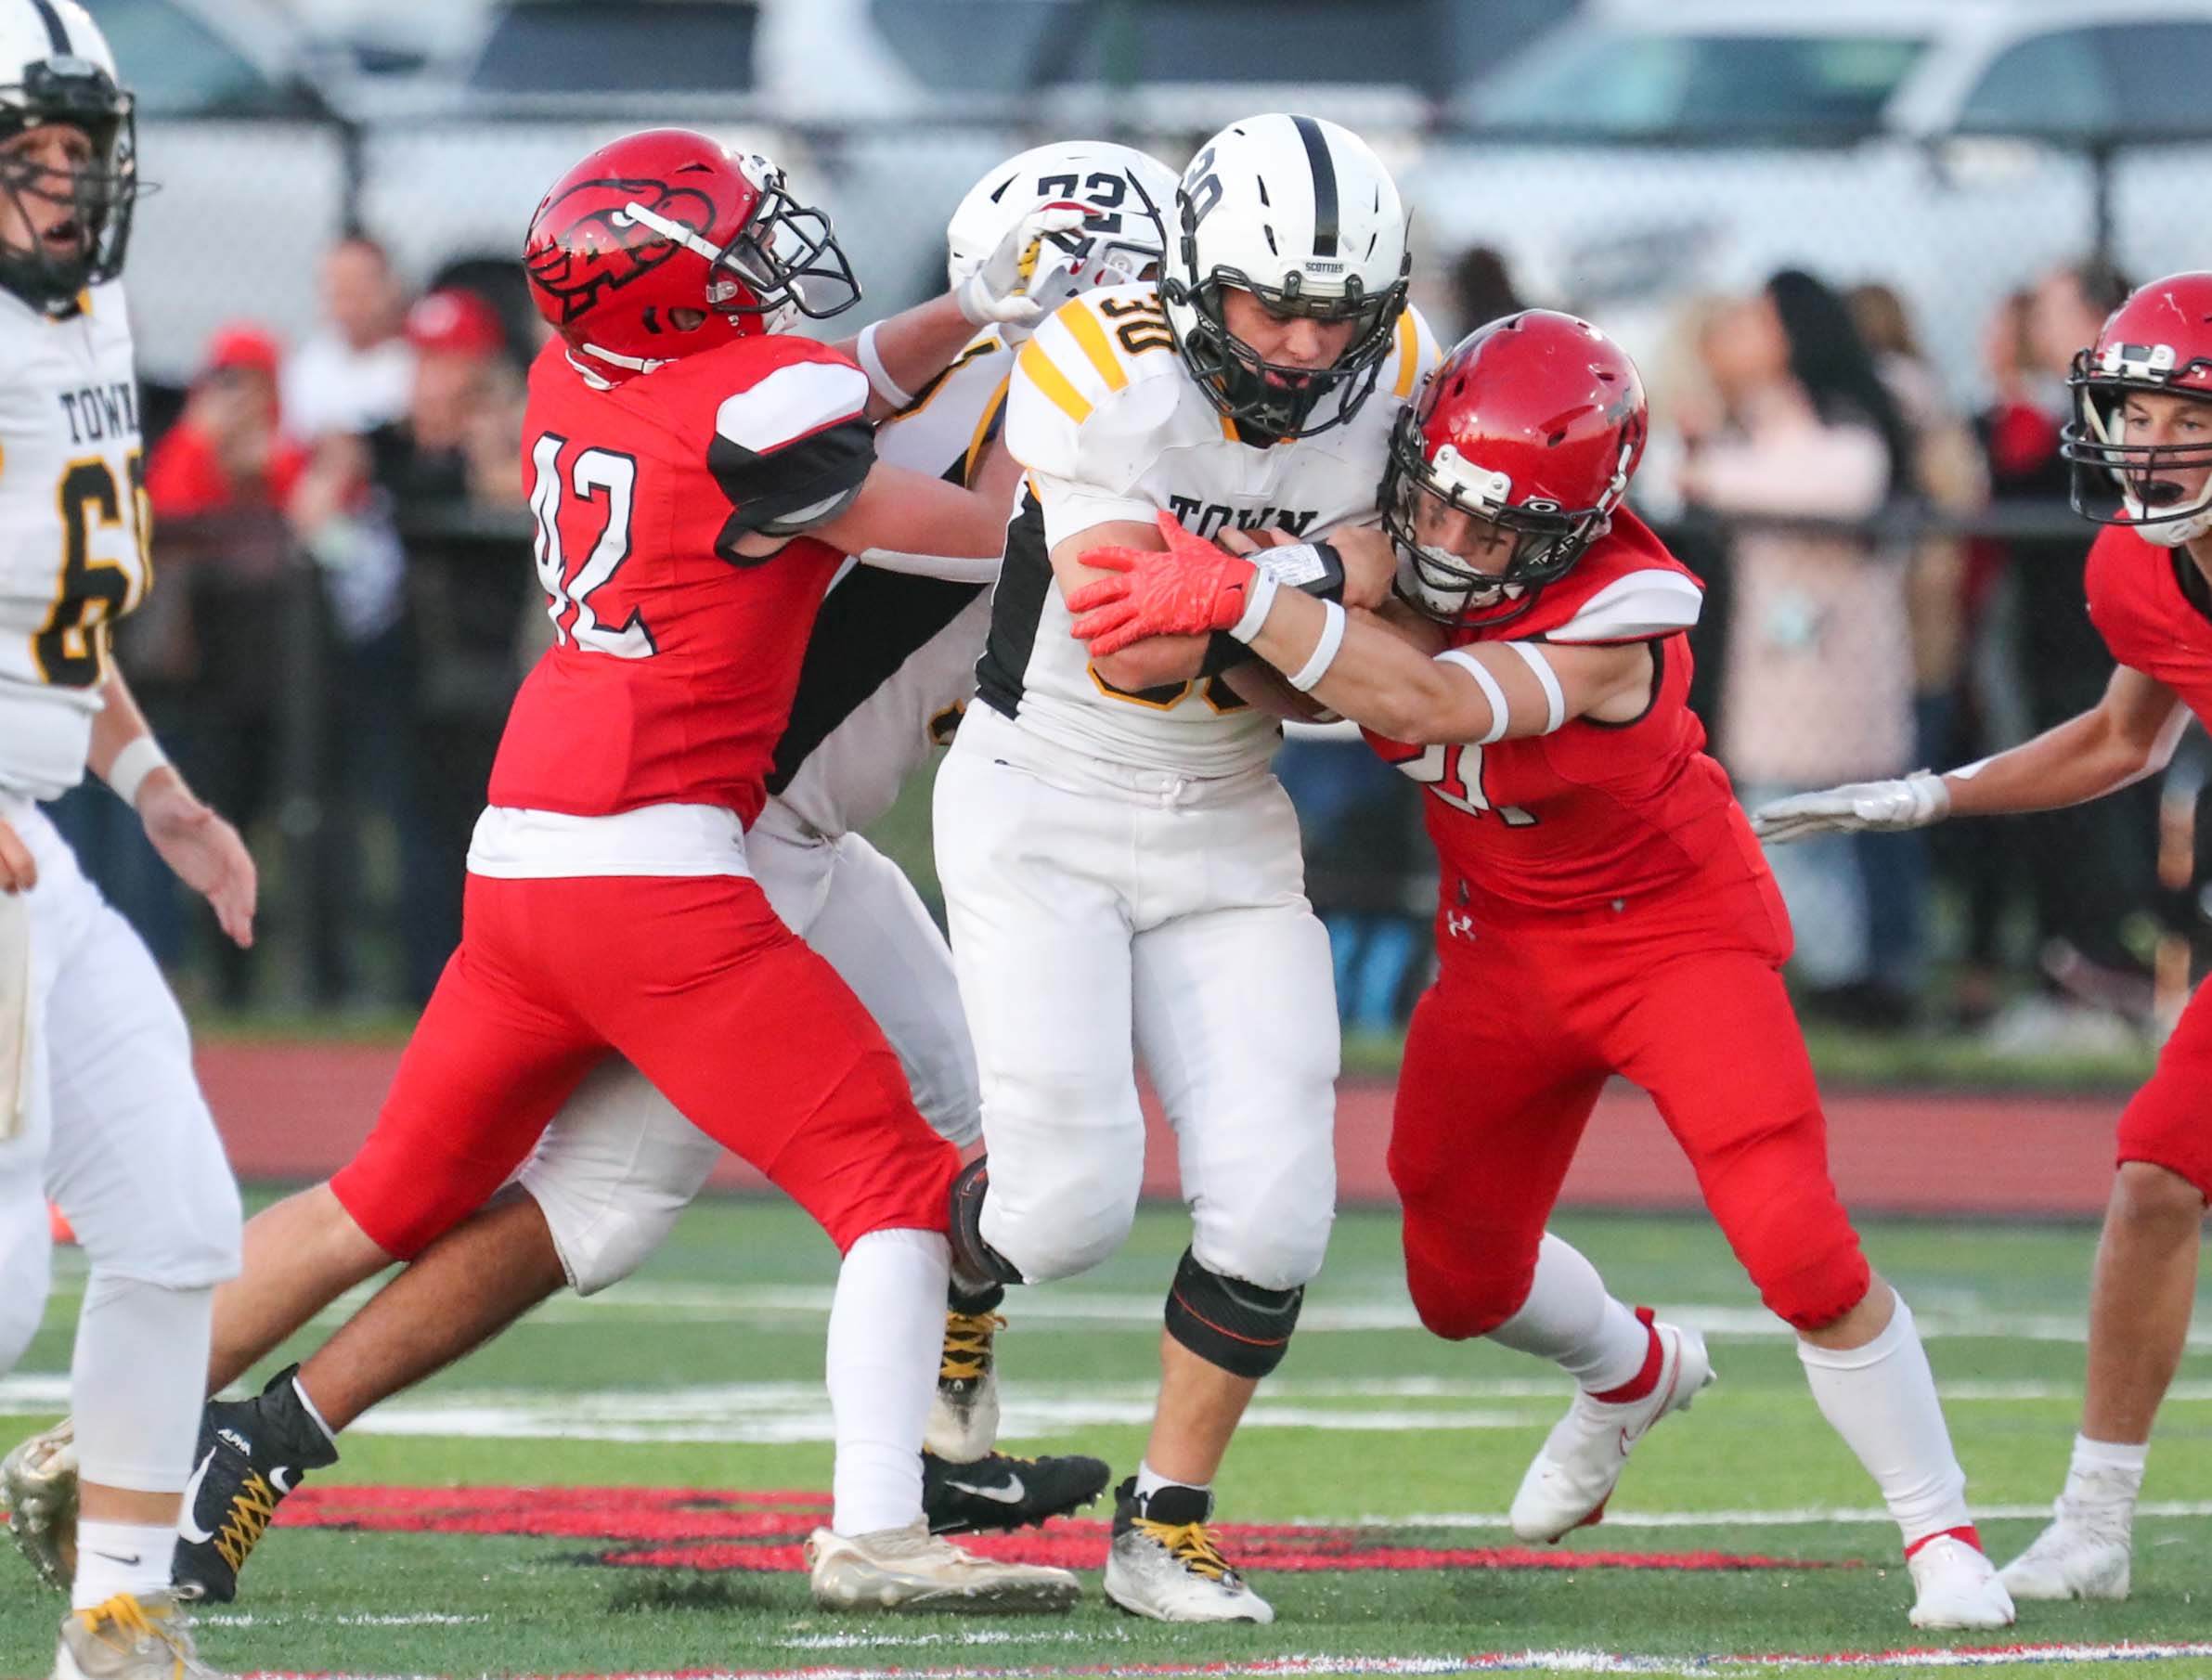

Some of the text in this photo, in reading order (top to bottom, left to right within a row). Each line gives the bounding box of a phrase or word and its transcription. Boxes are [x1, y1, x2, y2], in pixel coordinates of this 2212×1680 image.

[1037, 172, 1127, 234] 72
[1305, 262, 1344, 274] SCOTTIES
[1099, 292, 1180, 356] 30
[28, 450, 152, 686] 6
[528, 430, 660, 660] 42
[217, 1428, 251, 1456] ALPHA
